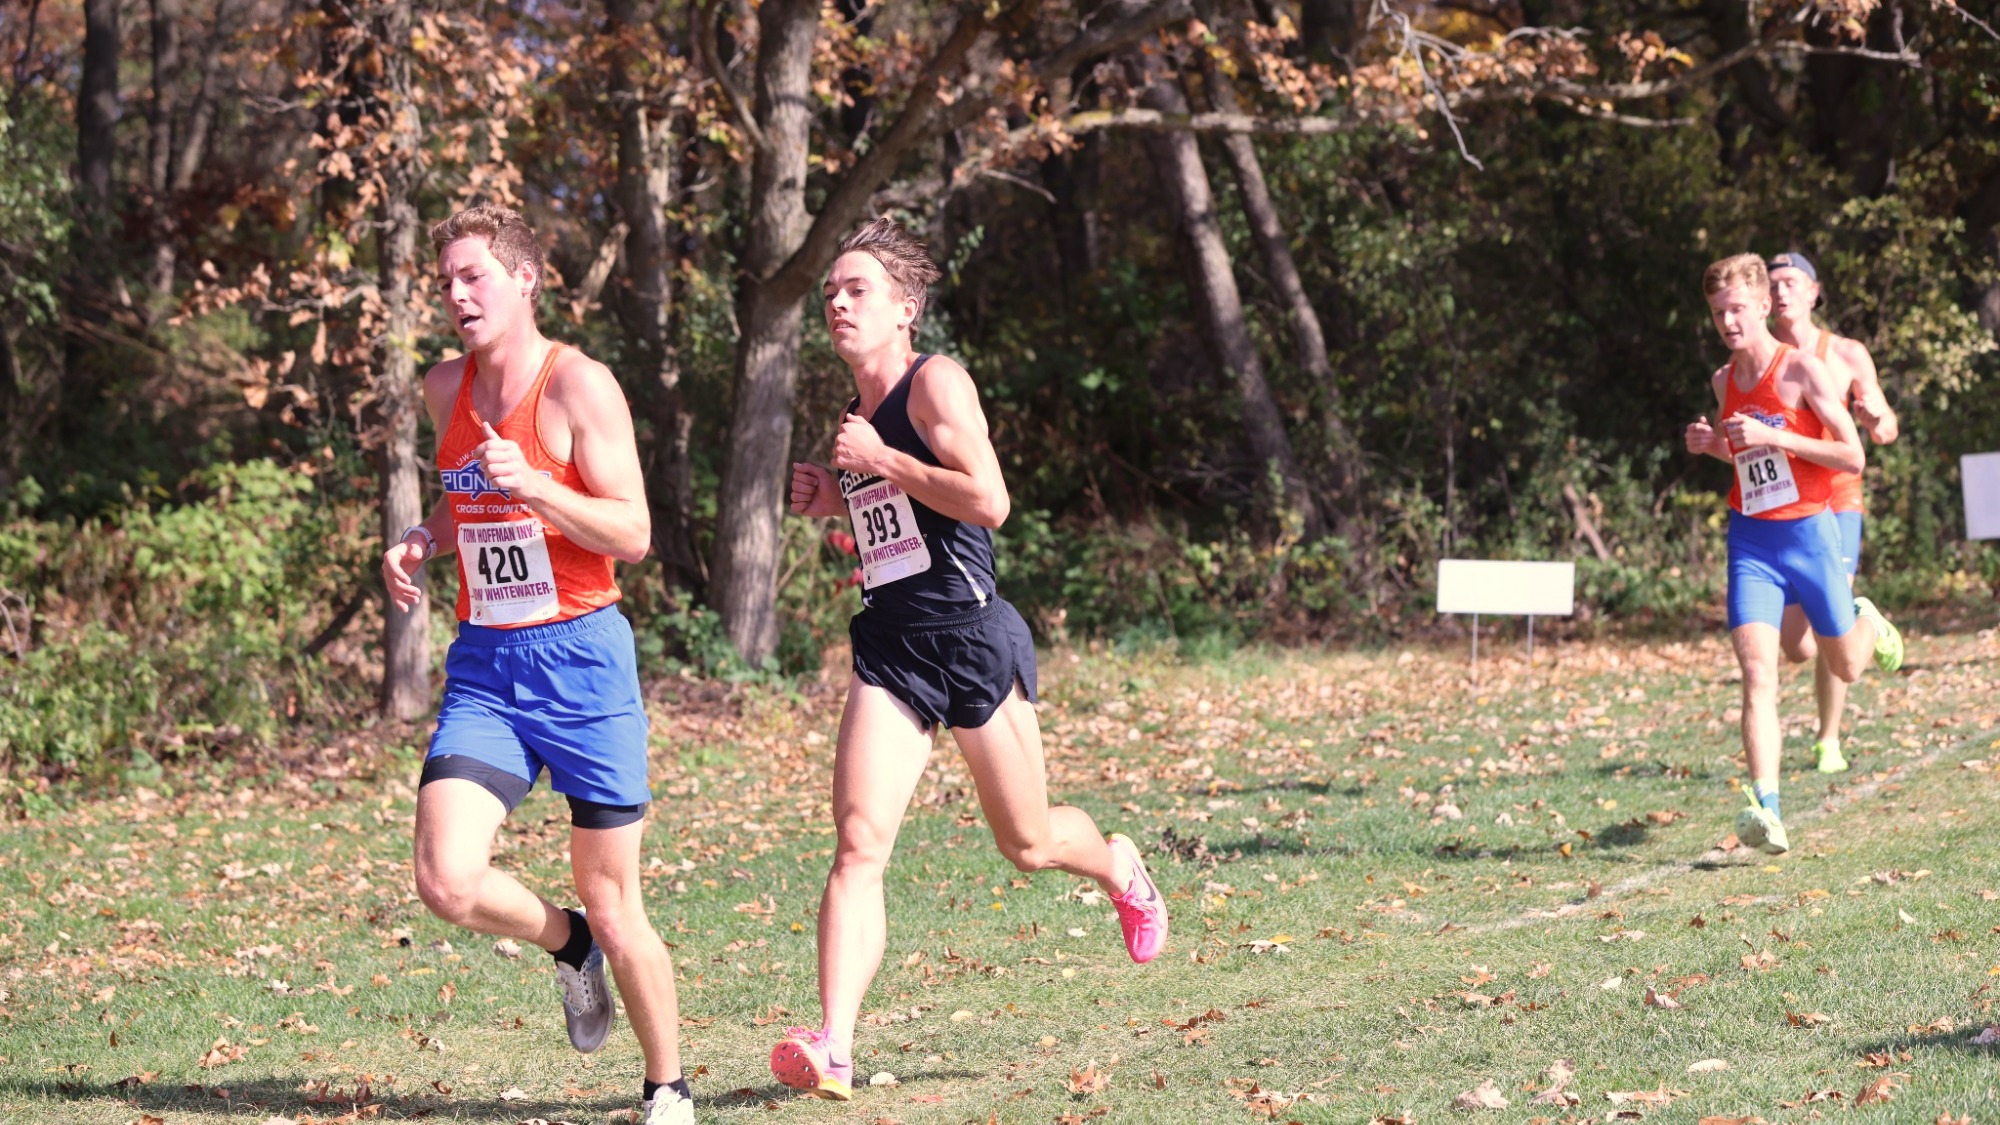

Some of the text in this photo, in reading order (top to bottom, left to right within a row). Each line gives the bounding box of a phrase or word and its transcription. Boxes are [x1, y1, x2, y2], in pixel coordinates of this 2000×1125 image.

[1748, 458, 1778, 487] 418
[456, 504, 485, 514] CROSS
[852, 494, 863, 510] TOM
[862, 485, 889, 507] HOFFMAN
[463, 528, 477, 543] TOM
[477, 526, 516, 543] HOFFMAN
[862, 502, 902, 547] 393
[478, 544, 529, 585] 420
[863, 550, 873, 566] UW
